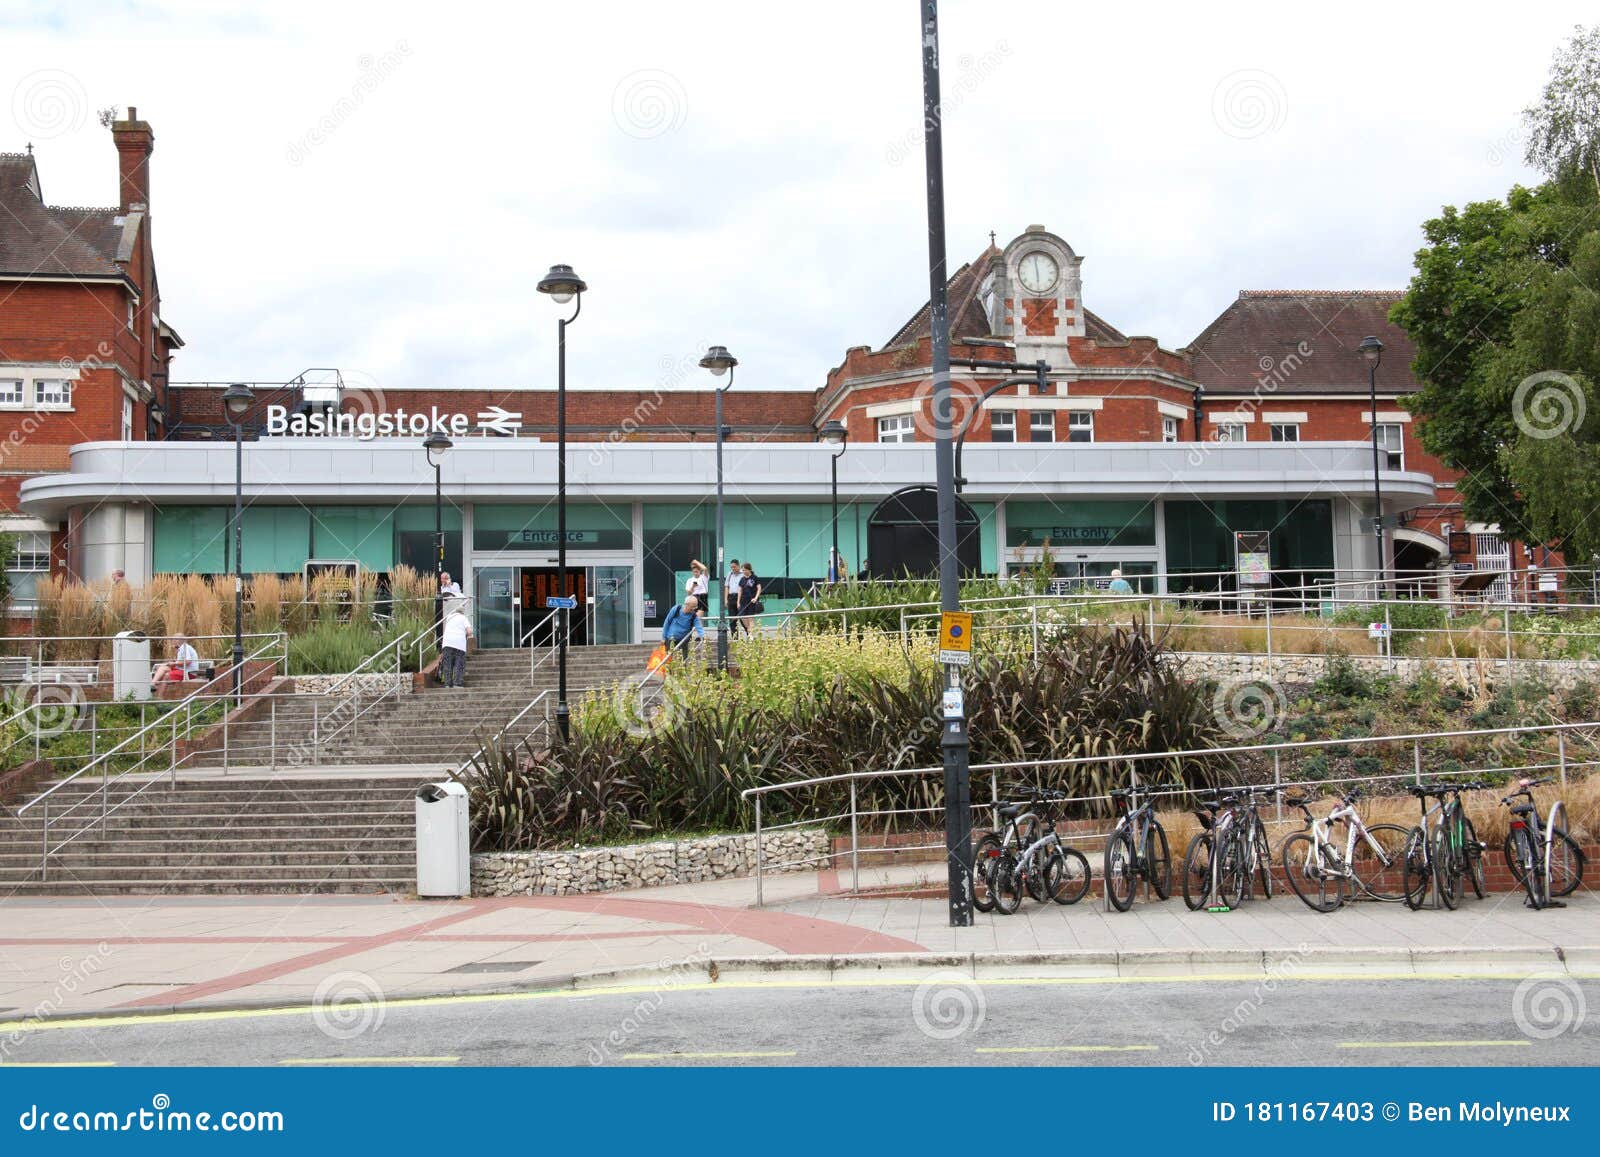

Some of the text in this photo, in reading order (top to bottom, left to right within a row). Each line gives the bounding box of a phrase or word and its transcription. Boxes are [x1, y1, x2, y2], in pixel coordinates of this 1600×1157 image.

[266, 404, 469, 441] Basingstoke
[523, 530, 584, 542] Entrace
[1053, 527, 1109, 540] Exit only
